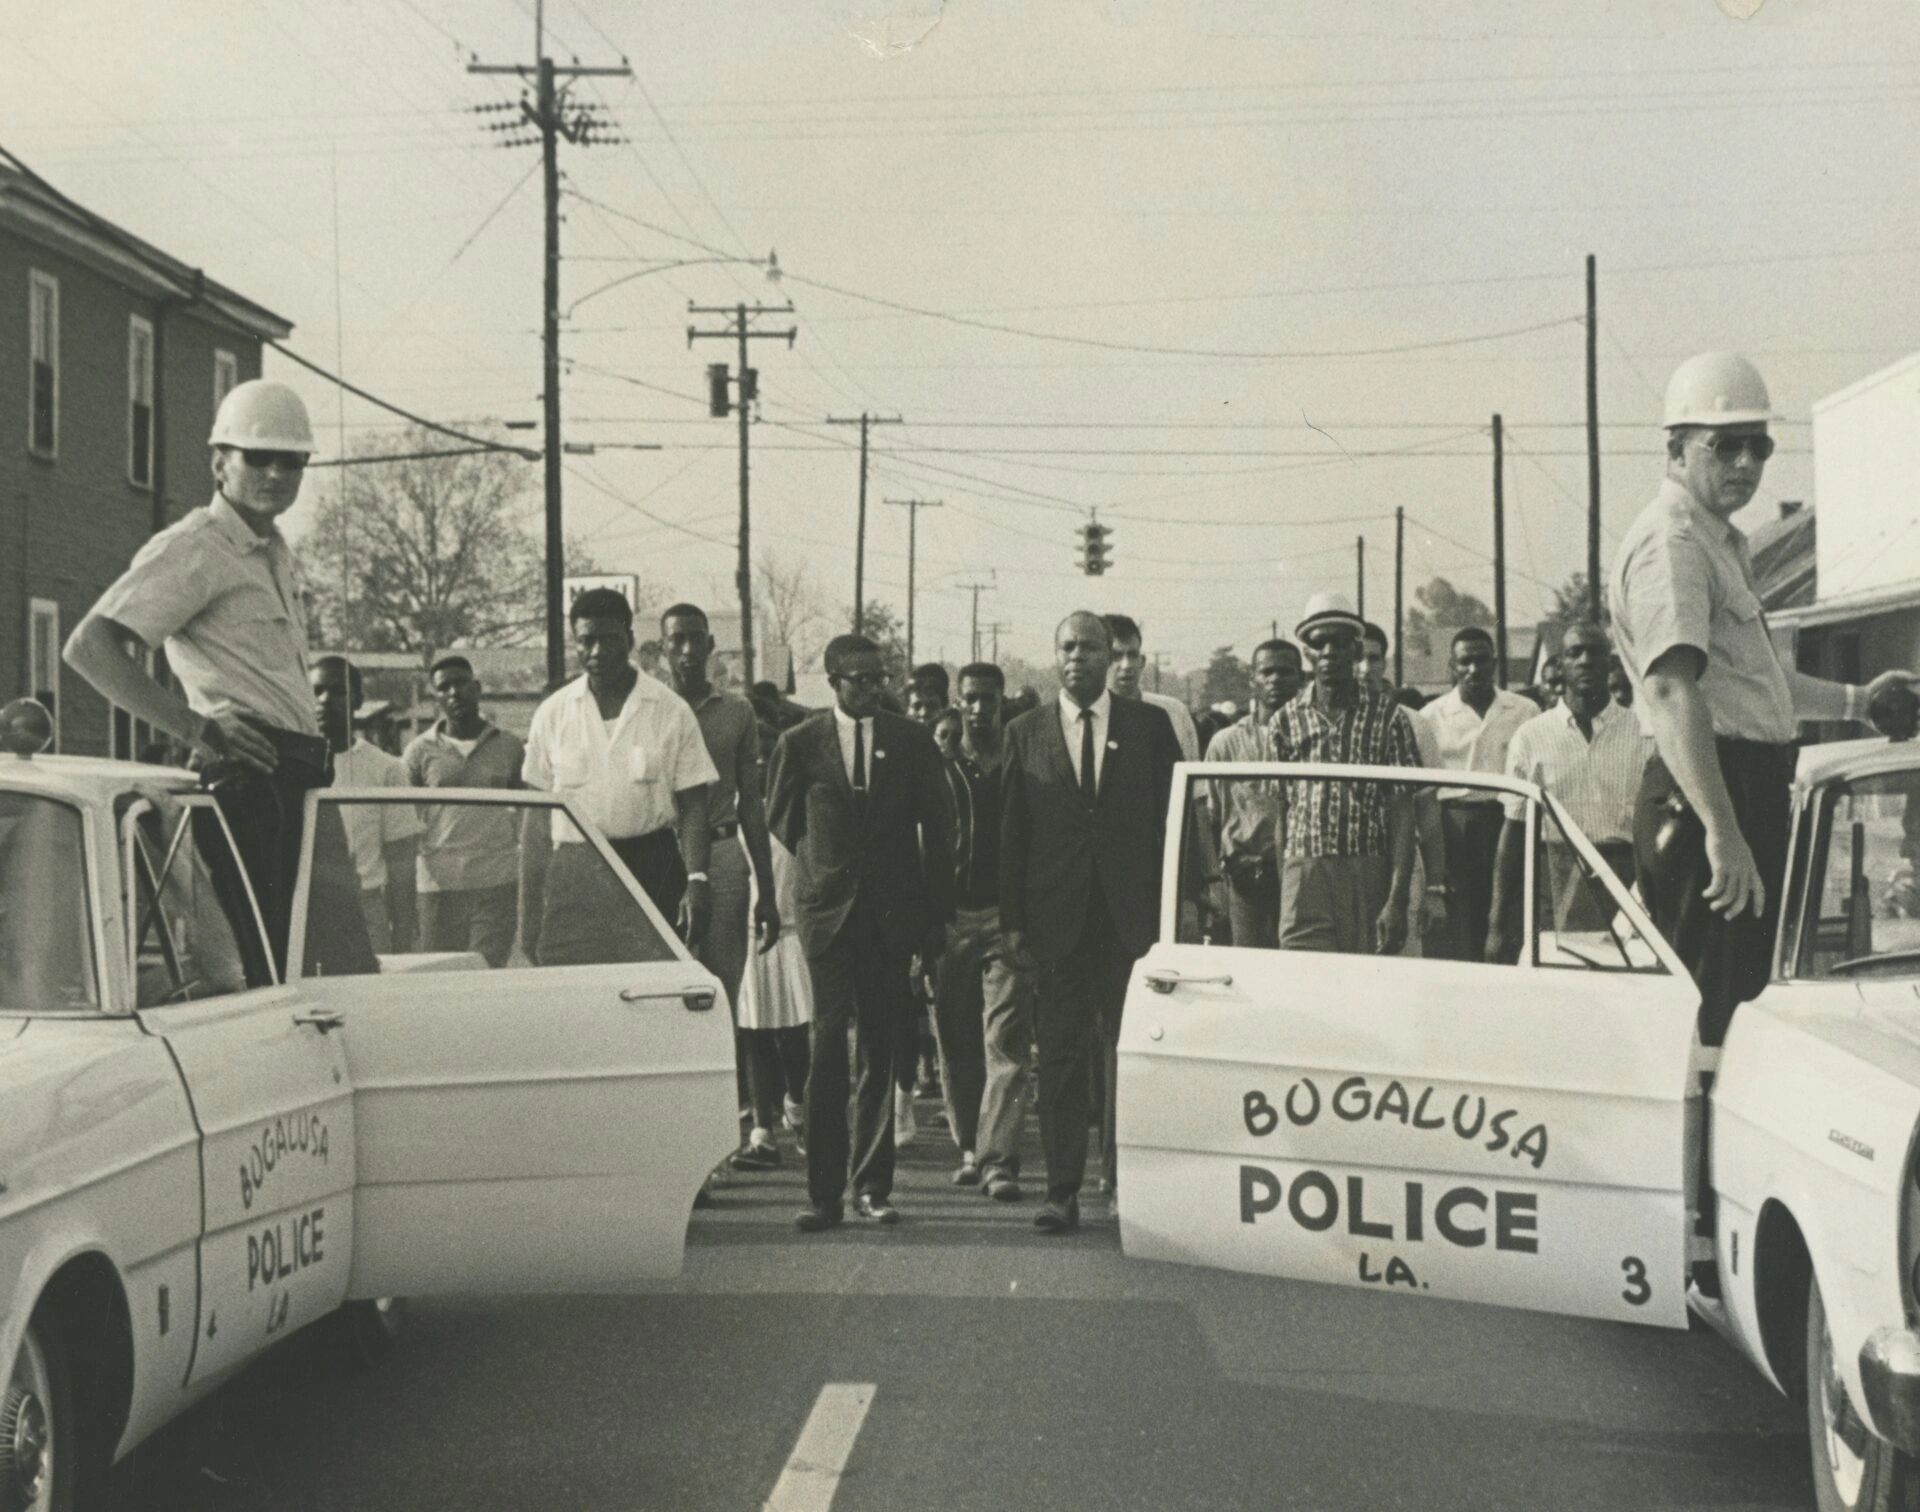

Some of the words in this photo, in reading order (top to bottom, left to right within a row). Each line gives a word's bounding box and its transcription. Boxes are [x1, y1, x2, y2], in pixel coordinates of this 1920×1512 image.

[240, 1112, 329, 1210] BOGALUSA
[1243, 1077, 1549, 1169] BOGALUSA
[247, 1208, 324, 1292] POLICE
[1239, 1165, 1539, 1254] POLICE
[1358, 1252, 1430, 1289] LA.
[1621, 1256, 1651, 1305] 3
